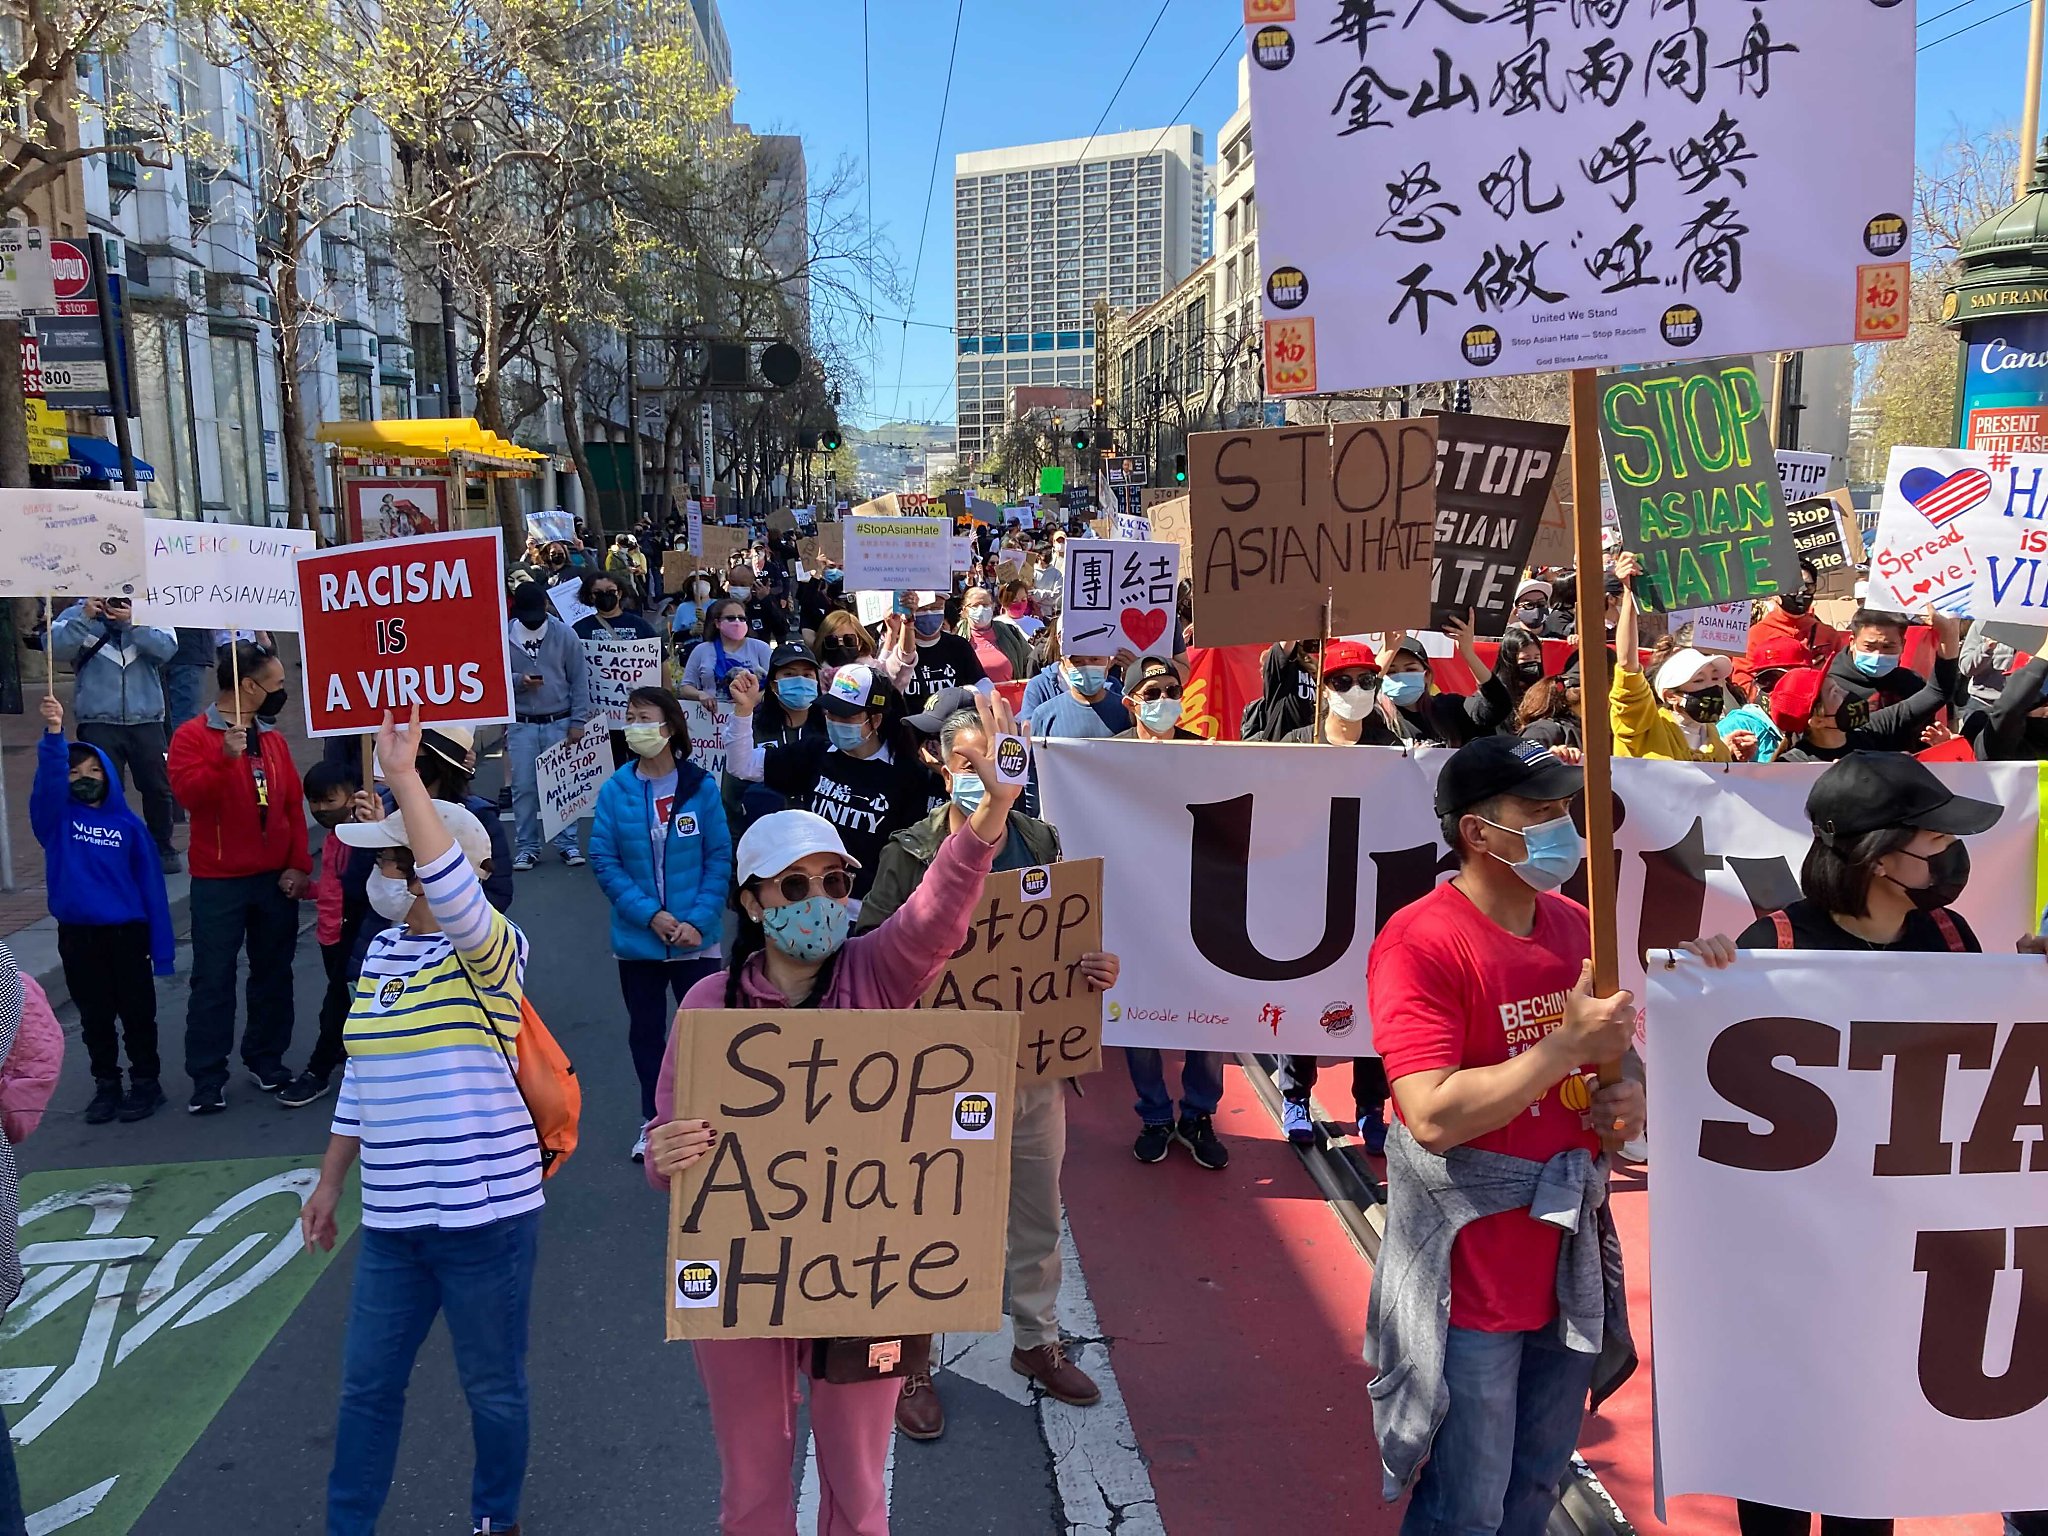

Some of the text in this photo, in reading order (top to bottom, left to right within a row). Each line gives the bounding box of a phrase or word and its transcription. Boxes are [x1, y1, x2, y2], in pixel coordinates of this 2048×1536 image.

[65, 303, 88, 315] stop
[1971, 293, 1998, 309] SAN
[1532, 308, 1618, 324] United We Stand
[41, 332, 48, 346] 7
[1511, 326, 1646, 346] Stop Asian Hate Stop Racism
[1536, 353, 1608, 366] God Bless America
[45, 371, 71, 385] 800
[1604, 366, 1764, 487] STOP
[1976, 415, 2040, 434] PRESENT
[1975, 436, 2008, 452] WITH
[1215, 426, 1438, 524] STOP
[1777, 462, 1826, 484] STOP
[898, 493, 928, 507] TOP
[901, 505, 929, 517] SIAN
[1639, 481, 1774, 543] ASIAN
[1788, 506, 1830, 528] Stop
[857, 524, 939, 536] #StopAsianHate
[1434, 510, 1517, 549] SIAN
[1793, 531, 1837, 551] Asian
[1204, 522, 1351, 593] ASIAN
[1362, 517, 1432, 573] HATE
[1878, 523, 1965, 579] Spread
[1806, 552, 1842, 571] ate
[1071, 550, 1173, 610] 團結
[1632, 535, 1779, 613] HATE
[319, 558, 472, 612] RACISM
[210, 584, 264, 603] ASIAN
[267, 589, 298, 607] HAT
[1698, 616, 1748, 631] ASIAN HATE
[376, 618, 407, 654] IS
[598, 643, 659, 657] Walk On By
[610, 656, 658, 668] ACTION
[600, 667, 643, 682] STOP
[1145, 668, 1166, 677] SAINTS
[325, 662, 484, 712] A VIRUS
[593, 723, 604, 734] By
[544, 747, 572, 775] TAKE
[576, 733, 610, 754] ACTION
[1001, 741, 1022, 756] STOP
[569, 752, 596, 773] STOP
[1000, 756, 1023, 771] HATE
[556, 782, 592, 811] Attacks
[811, 795, 885, 833] UNITY
[73, 820, 122, 840] NUEVA
[1026, 871, 1045, 882] STOP
[1026, 880, 1045, 890] HATE
[1127, 1007, 1229, 1025] Noodle House
[1507, 1026, 1540, 1044] SAN
[720, 1022, 974, 1142] Stop
[961, 1100, 988, 1113] STOP
[961, 1112, 986, 1125] HATE
[680, 1131, 965, 1233] Asian
[683, 1268, 711, 1281] STOP
[722, 1235, 969, 1328] Hate
[685, 1279, 711, 1292] HATE
